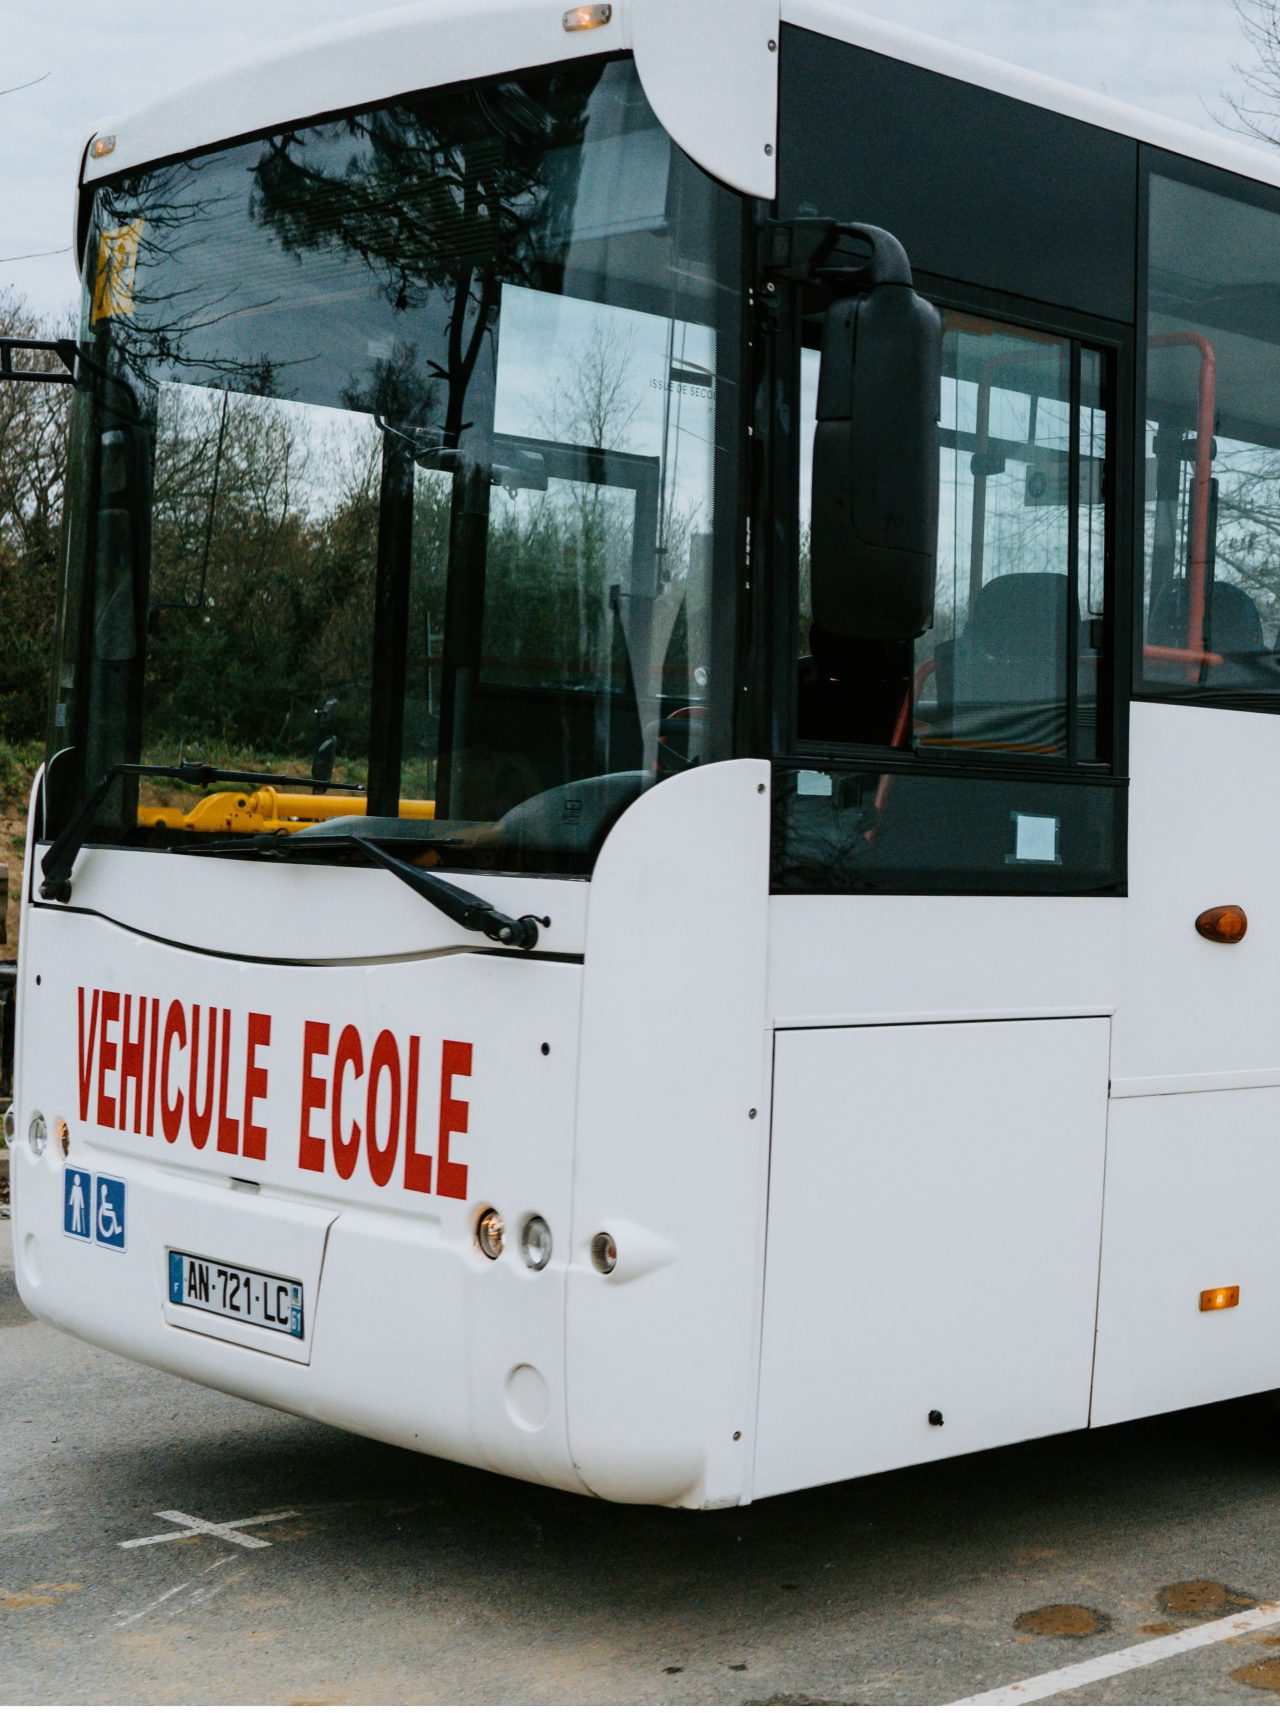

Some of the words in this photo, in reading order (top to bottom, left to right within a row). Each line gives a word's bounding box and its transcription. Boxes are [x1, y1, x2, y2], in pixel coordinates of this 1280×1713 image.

[676, 384, 687, 395] DE
[77, 986, 272, 1161] VEHICULE
[298, 1020, 473, 1201] ECOLE
[173, 1282, 180, 1293] F
